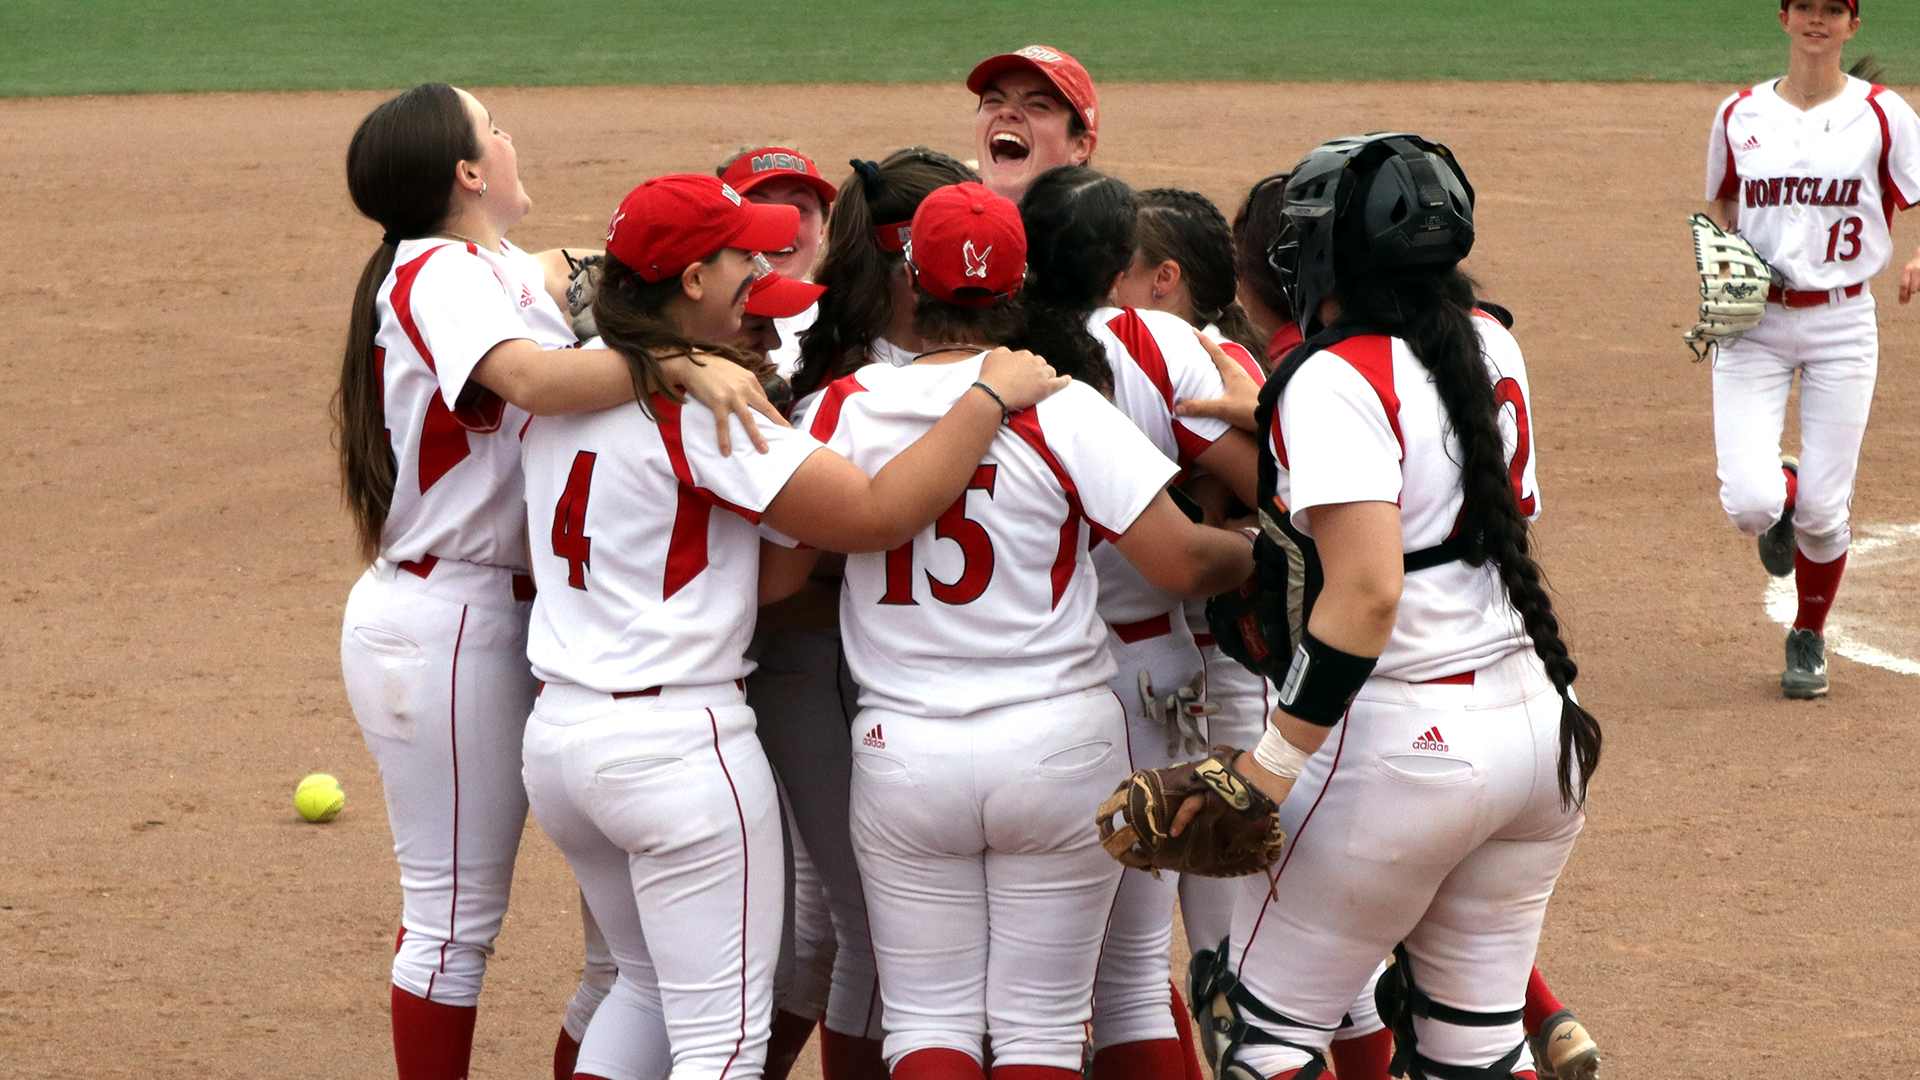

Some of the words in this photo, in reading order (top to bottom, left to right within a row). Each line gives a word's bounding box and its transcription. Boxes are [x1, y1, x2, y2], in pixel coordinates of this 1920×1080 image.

[751, 153, 808, 175] MSU
[1744, 177, 1862, 208] MONTCLAIR
[1823, 216, 1863, 264] 13
[551, 450, 597, 592] 4
[1412, 740, 1449, 753] adidas
